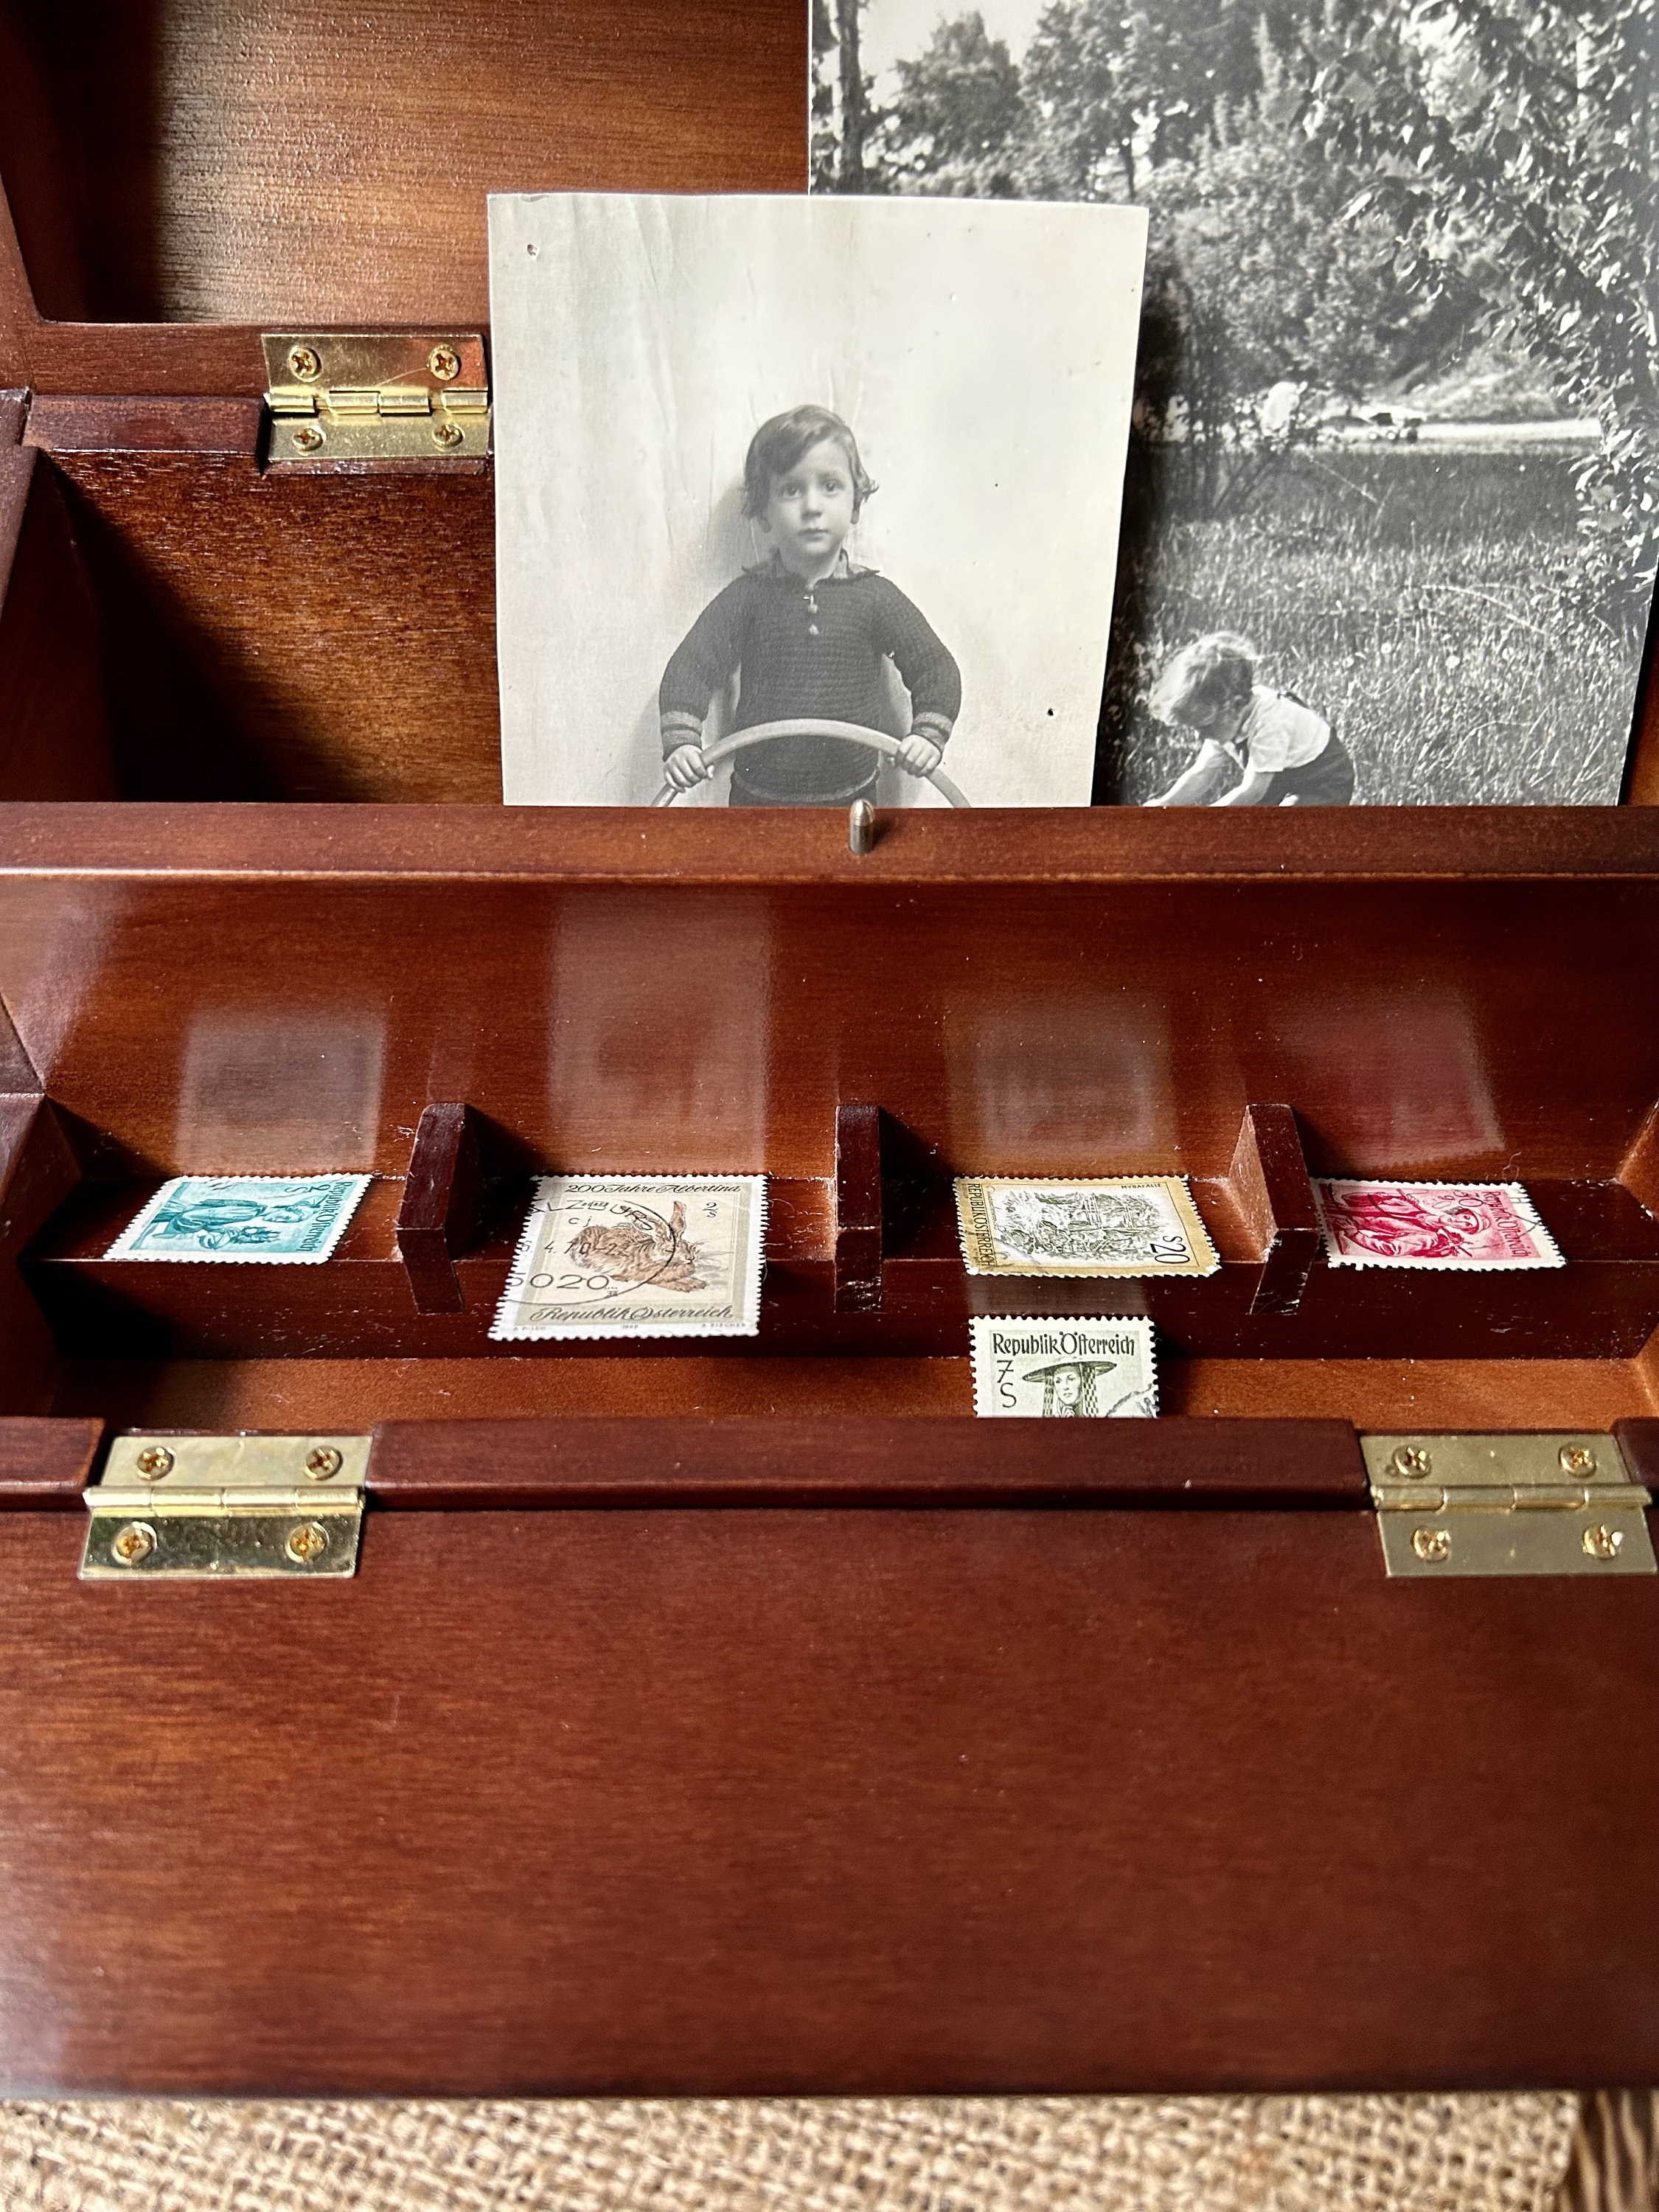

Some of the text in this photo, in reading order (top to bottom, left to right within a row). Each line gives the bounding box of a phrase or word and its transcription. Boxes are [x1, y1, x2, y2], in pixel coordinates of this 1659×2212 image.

[309, 1184, 331, 1193] 2
[319, 1182, 353, 1214] Republik
[566, 1184, 741, 1194] 200 Jahre Albertina
[967, 1183, 987, 1217] REPUBLIK
[703, 1203, 718, 1211] 2
[1482, 1191, 1511, 1220] Republik
[529, 1307, 634, 1321] Republik
[992, 1333, 1062, 1356] Republik
[996, 1360, 1014, 1383] 7
[1000, 1382, 1017, 1408] S
